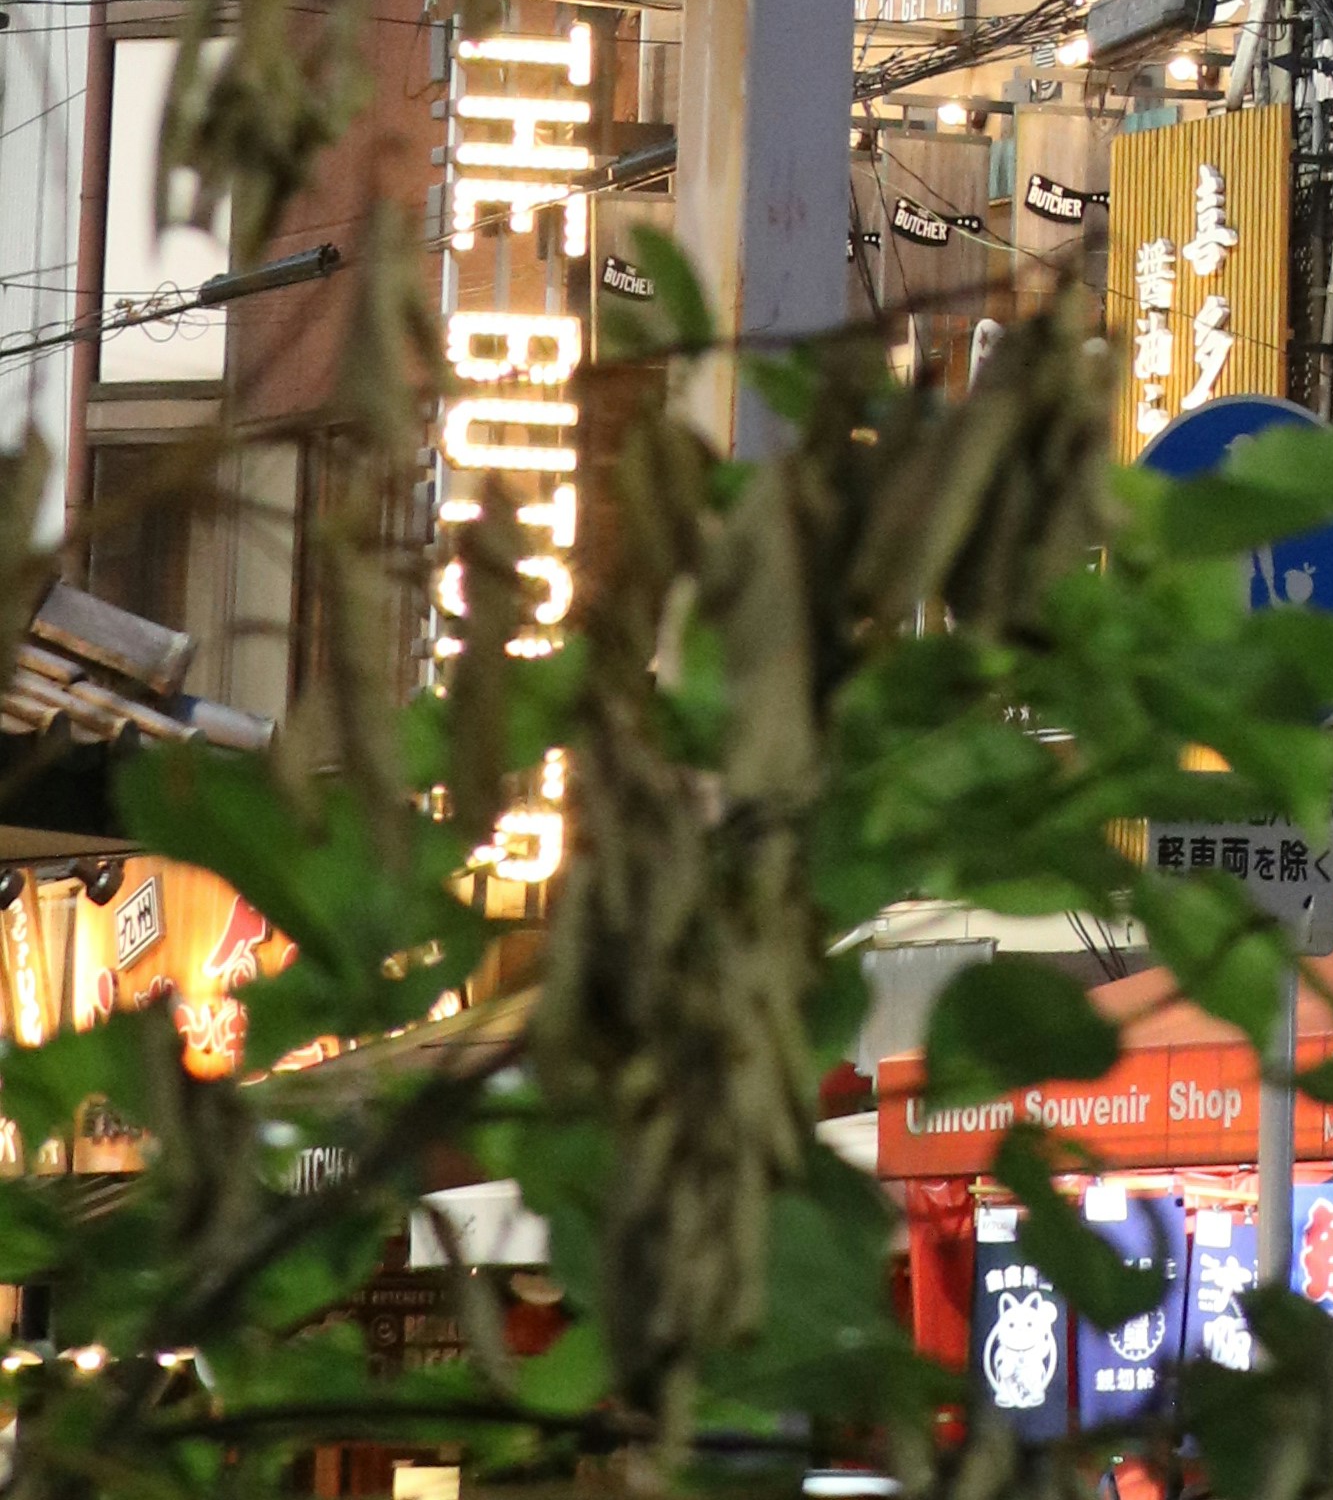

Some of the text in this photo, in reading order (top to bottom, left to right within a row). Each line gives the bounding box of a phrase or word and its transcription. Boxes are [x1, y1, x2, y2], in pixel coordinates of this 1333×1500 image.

[453, 20, 594, 257] THE
[894, 208, 949, 241] BUTCHER
[1028, 186, 1083, 218] BUTCHER
[1158, 835, 1331, 883] 軽車両を除く
[119, 889, 154, 953] 九州
[1025, 1085, 1150, 1129] Souvenir
[1169, 1080, 1242, 1128] Shop
